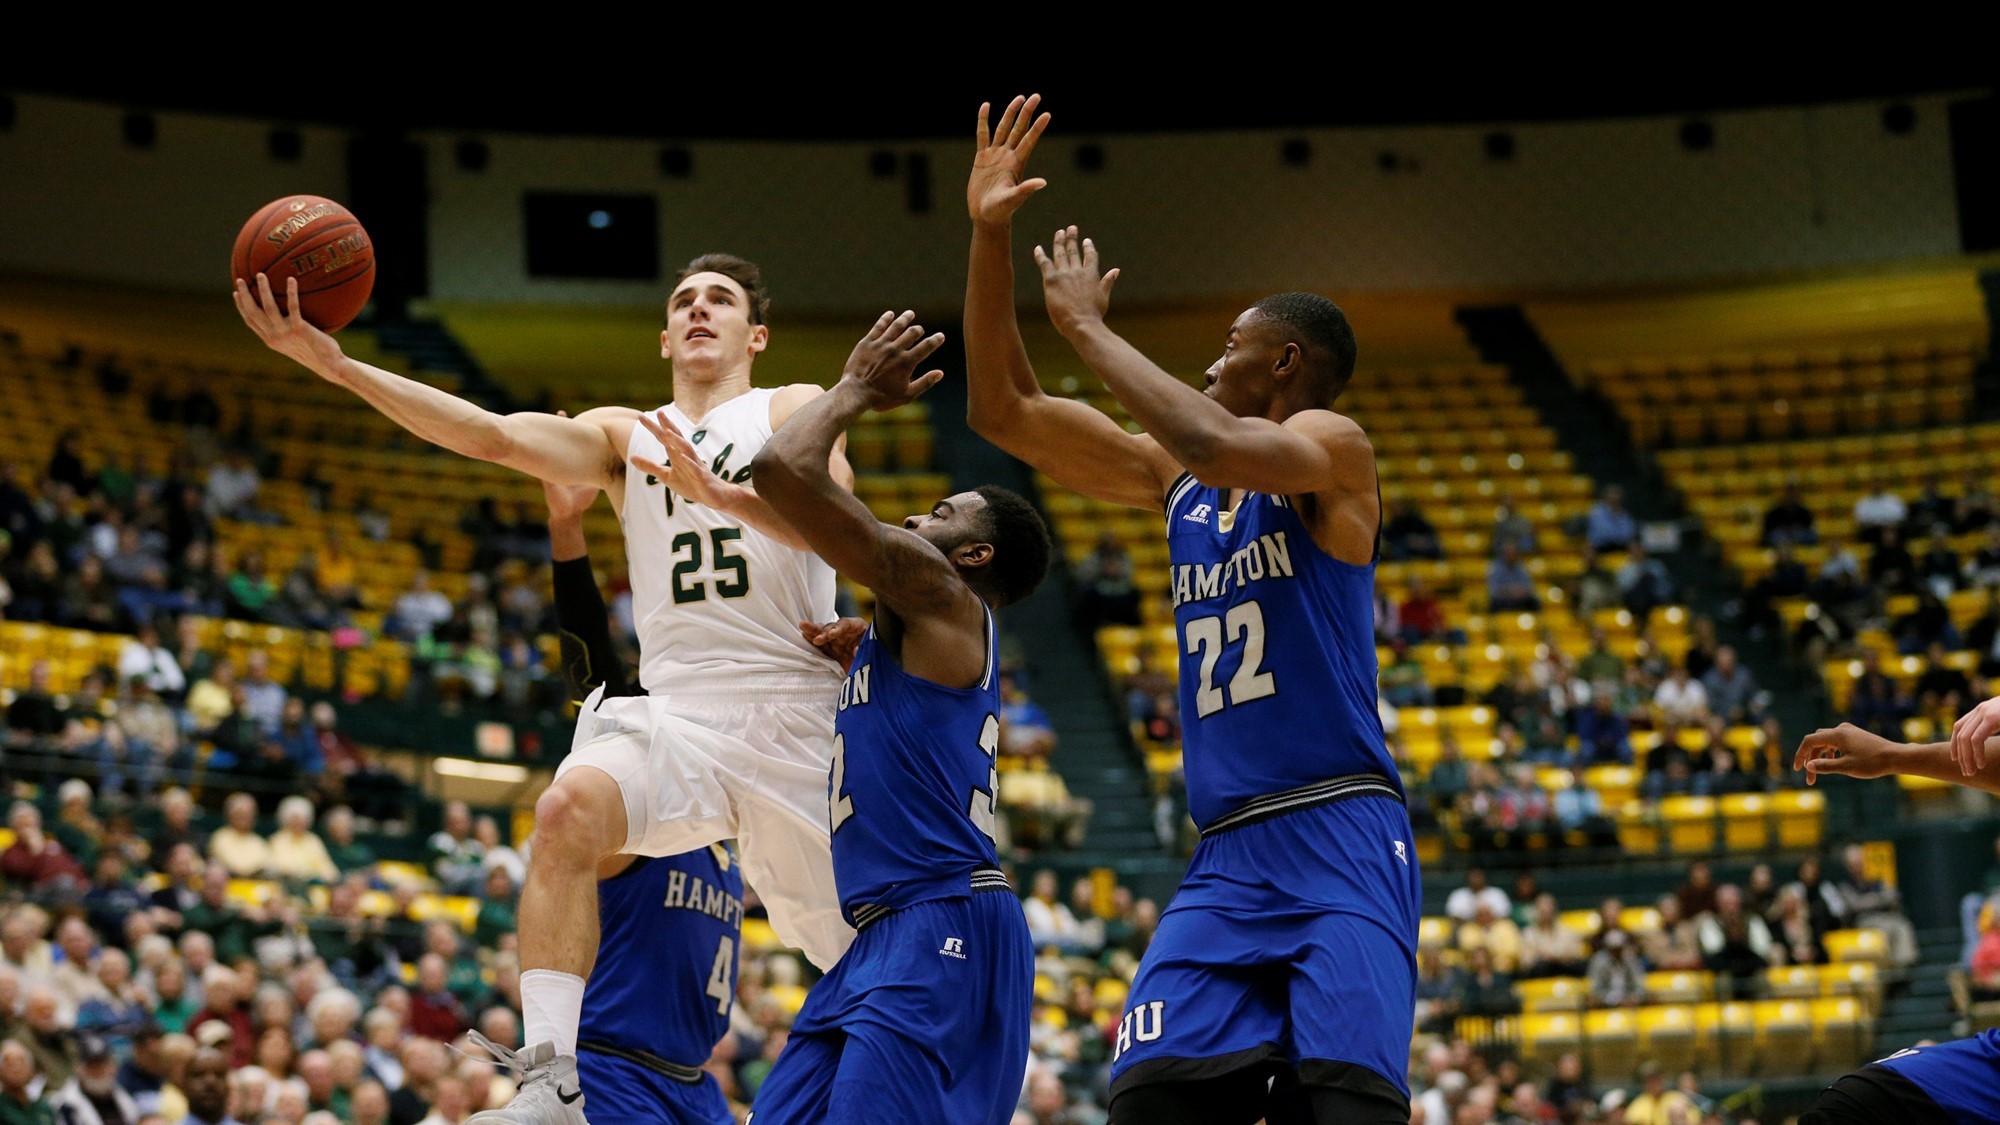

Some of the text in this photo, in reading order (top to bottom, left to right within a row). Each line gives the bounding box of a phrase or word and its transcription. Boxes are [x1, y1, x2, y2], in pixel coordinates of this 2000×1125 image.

[267, 203, 341, 250] SPALDI
[1182, 514, 1209, 525] RUSSELL
[671, 526, 750, 606] 25
[1185, 600, 1276, 719] 22
[664, 869, 744, 931] HAMPT
[706, 935, 733, 1016] 4
[939, 949, 967, 960] RUSSELL
[1113, 1001, 1164, 1063] HU
